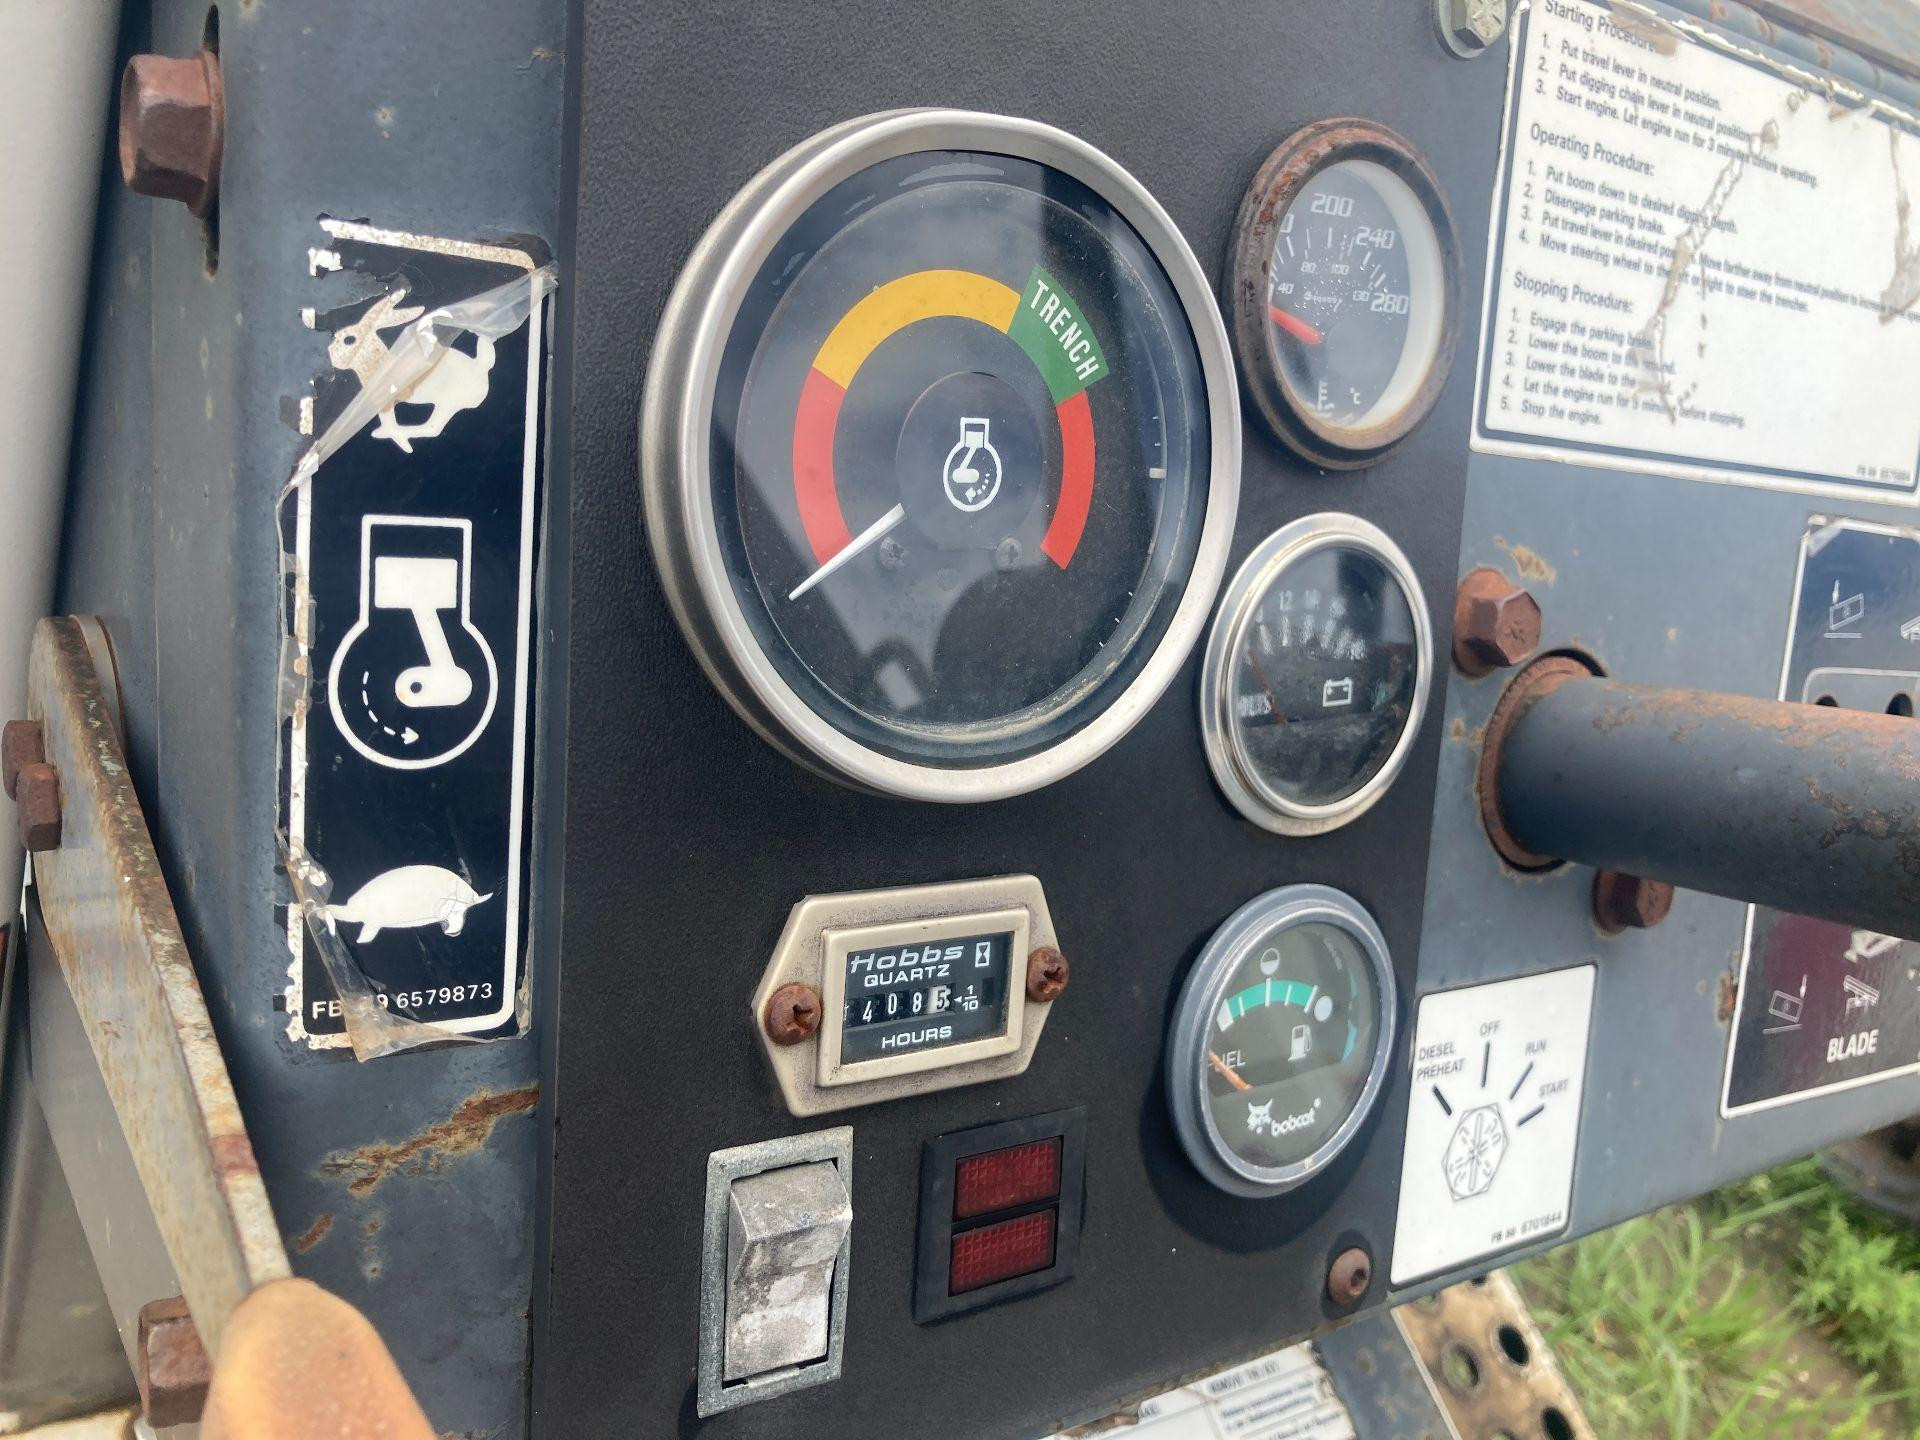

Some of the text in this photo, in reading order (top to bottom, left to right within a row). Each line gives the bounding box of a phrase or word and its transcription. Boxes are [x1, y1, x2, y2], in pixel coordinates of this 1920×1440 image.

[1545, 0, 1594, 31] Starting
[1561, 40, 1578, 59] Put
[1582, 48, 1610, 70] travel
[1612, 58, 1635, 78] lever
[1638, 68, 1648, 83] in
[1650, 76, 1683, 96] neutral
[1684, 88, 1721, 111] position.
[1559, 63, 1576, 82] Put
[1579, 70, 1616, 99] digging
[1619, 85, 1645, 106] chain
[1647, 94, 1670, 114] lever
[1672, 102, 1682, 118] in
[1683, 109, 1715, 131] neutral
[1556, 86, 1582, 108] Start
[1585, 98, 1620, 119] engine.
[1623, 107, 1639, 126] Let
[1641, 117, 1672, 138] engine
[1674, 128, 1690, 143] run
[1692, 131, 1706, 148] for
[1707, 137, 1716, 151] 3
[1530, 122, 1655, 177] Operating Procedure:
[1310, 193, 1353, 218] 200
[1546, 165, 1564, 184] Put
[1566, 170, 1595, 193] boom
[1598, 181, 1626, 202] down
[1628, 190, 1639, 205] to
[1641, 193, 1674, 216] desired
[1544, 188, 1597, 218] Disengage
[1599, 206, 1635, 231] parking
[1637, 213, 1666, 235] brake.
[1355, 227, 1394, 250] 240
[1540, 233, 1568, 254] Move
[1569, 243, 1610, 267] steering
[1612, 253, 1641, 272] wheel
[1643, 261, 1654, 275] to
[1542, 210, 1559, 229] Put
[1561, 217, 1589, 236] travel
[1590, 223, 1613, 241] lever
[1614, 229, 1623, 244] in
[1624, 235, 1659, 255] desired
[1699, 251, 1722, 271] Move
[1277, 282, 1294, 295] 40
[1370, 293, 1409, 315] 280
[1514, 270, 1634, 313] Stopping Procedure:
[1030, 279, 1100, 381] TRENCH
[1530, 311, 1567, 335] Engage
[1571, 319, 1586, 337] the
[1589, 326, 1625, 348] parking
[1528, 333, 1559, 351] Lower
[1562, 339, 1578, 357] the
[1581, 344, 1609, 363] boom
[1611, 350, 1622, 364] to
[1526, 355, 1556, 374] Lower
[1560, 361, 1576, 378] the
[1579, 366, 1605, 383] blade
[1608, 371, 1618, 386] to
[1620, 373, 1636, 389] the
[1523, 376, 1539, 393] Let
[1543, 381, 1559, 397] the
[1562, 386, 1594, 405] engine
[1597, 392, 1613, 406] run
[1616, 392, 1629, 408] for
[1521, 399, 1545, 420] Stop
[1549, 405, 1565, 421] the
[1567, 409, 1602, 427] engine.
[850, 945, 965, 974] Hobbs
[864, 964, 951, 987] QUARTZ
[396, 982, 493, 1010] 6579873
[881, 1025, 953, 1049] HOURS
[1480, 1020, 1501, 1037] OFF
[1418, 1041, 1456, 1061] DIESEL
[1525, 1039, 1547, 1056] RUN
[1826, 1029, 1880, 1063] BLADE
[1416, 1058, 1465, 1082] PREHEAT
[1538, 1078, 1570, 1098] START
